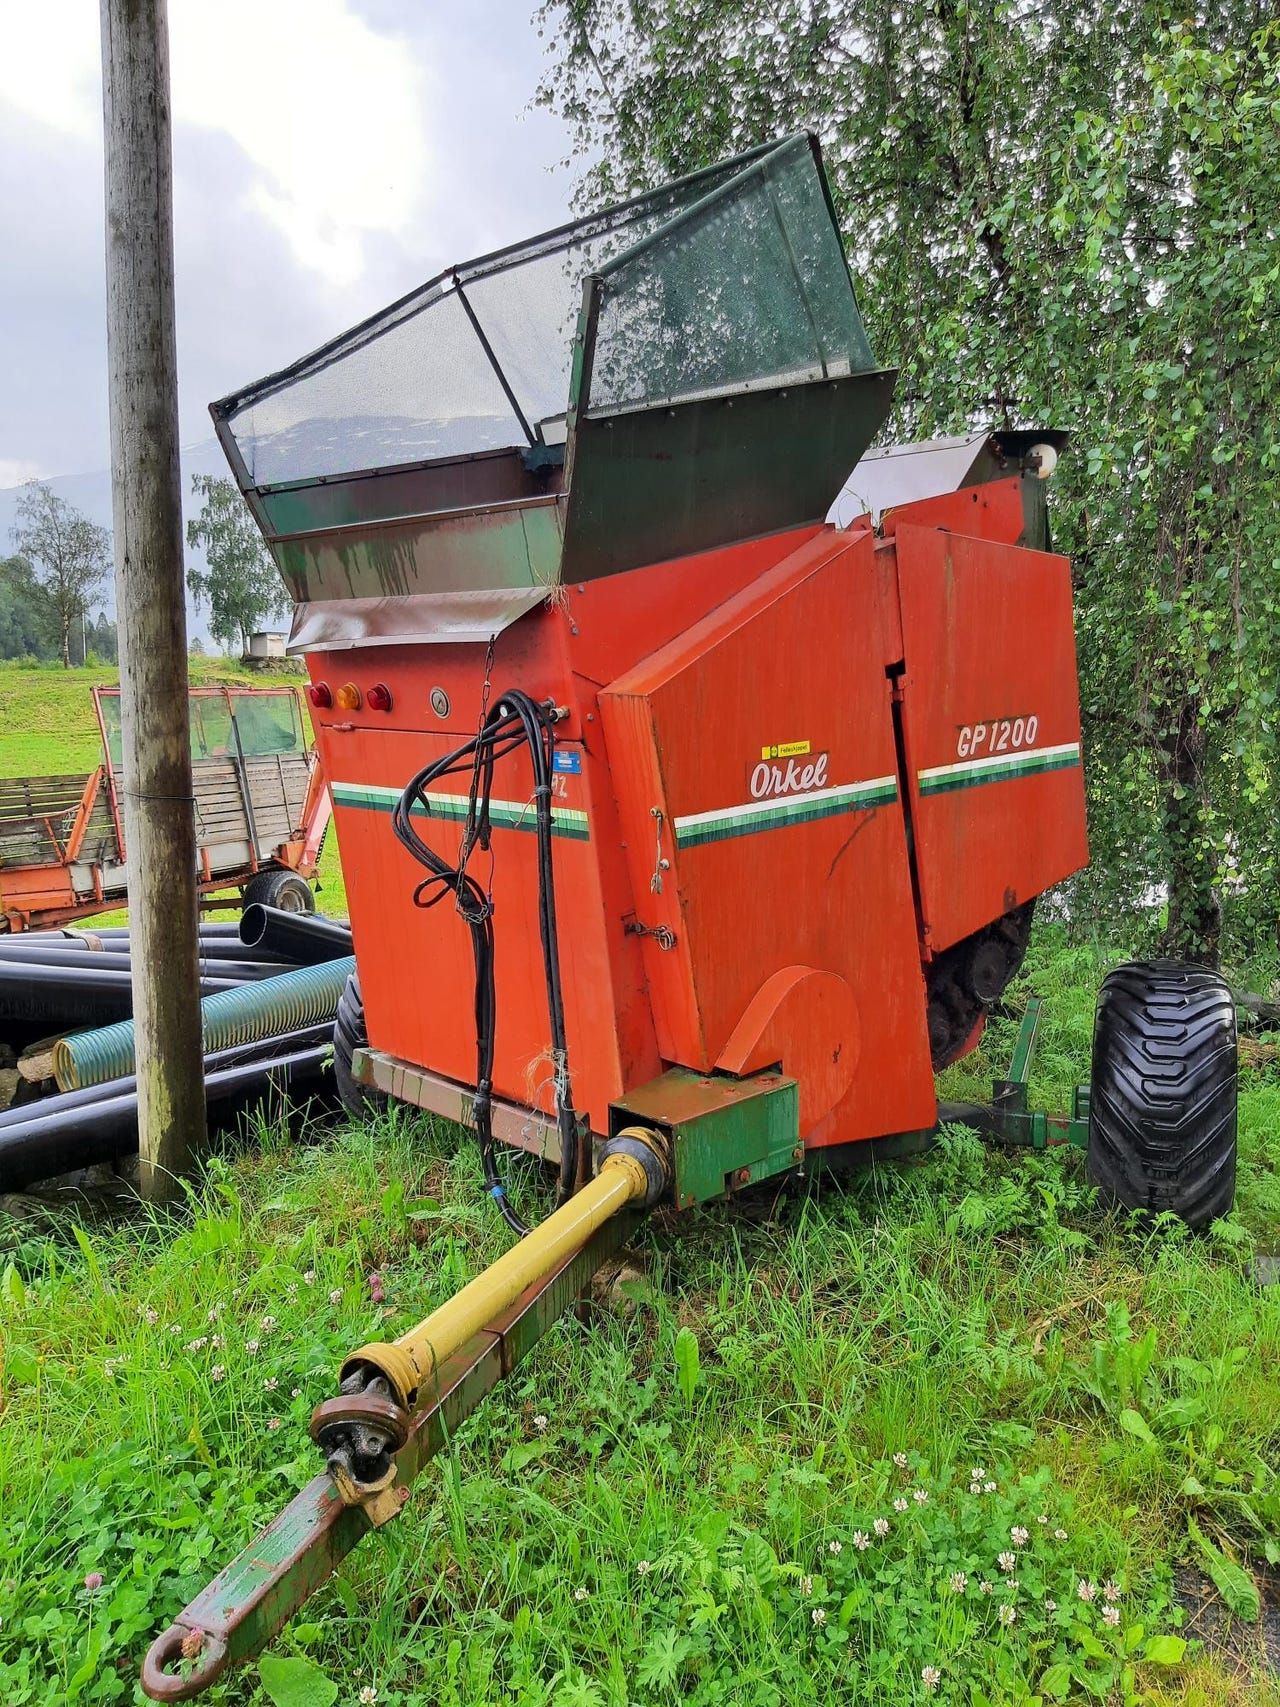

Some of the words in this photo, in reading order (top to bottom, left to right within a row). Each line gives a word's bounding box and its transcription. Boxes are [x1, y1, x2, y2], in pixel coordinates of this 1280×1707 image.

[957, 724, 986, 757] GP
[989, 715, 1038, 752] 1200
[750, 753, 828, 798] Orkel
